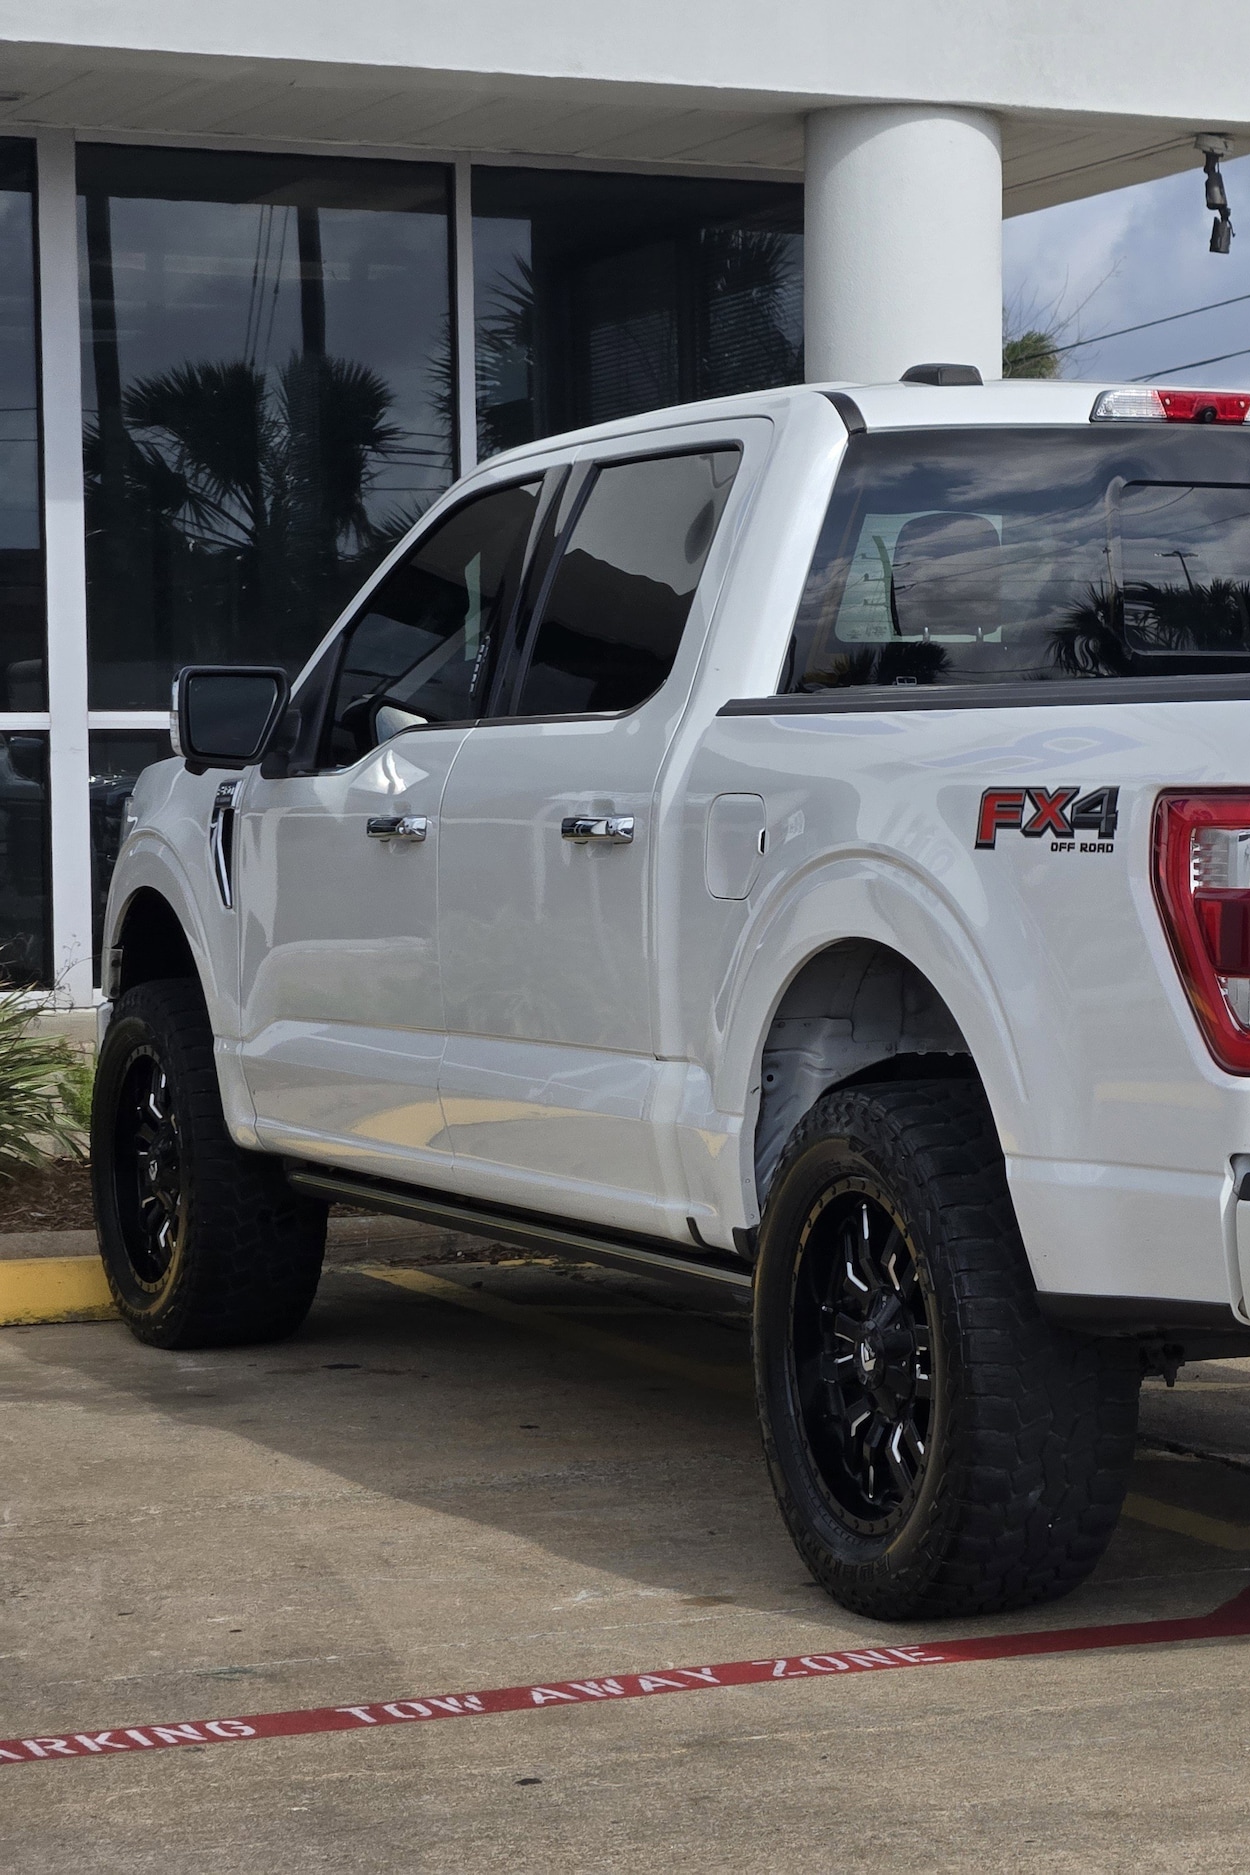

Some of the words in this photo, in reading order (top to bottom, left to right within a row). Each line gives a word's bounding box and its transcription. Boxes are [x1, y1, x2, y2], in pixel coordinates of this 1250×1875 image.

[974, 786, 1121, 850] FX4
[1051, 842, 1075, 852] OFF
[1080, 843, 1114, 853] ROAD
[335, 1694, 486, 1724] TOW
[530, 1666, 721, 1705] AWAY
[752, 1645, 945, 1678] ZONE
